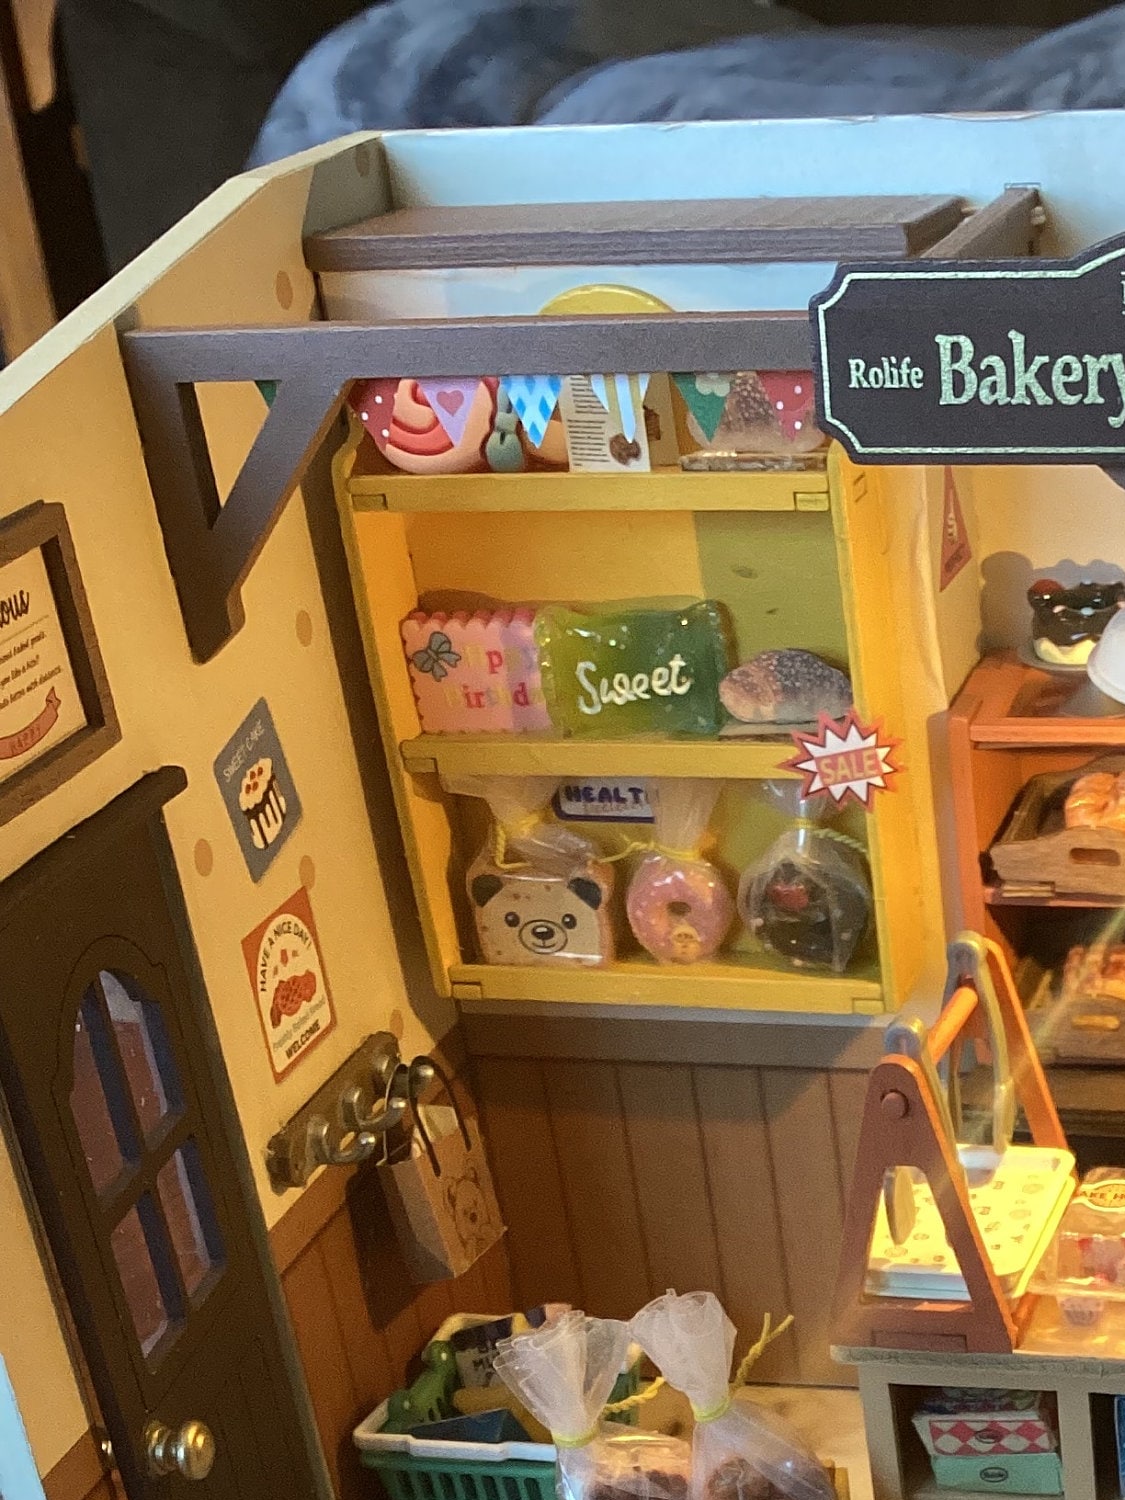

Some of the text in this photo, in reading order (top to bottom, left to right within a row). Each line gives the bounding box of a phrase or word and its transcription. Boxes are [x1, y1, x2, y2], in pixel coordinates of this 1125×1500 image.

[848, 357, 924, 392] Rolife
[575, 653, 693, 716] Sweet
[223, 719, 265, 783] SWEET CAKE
[820, 749, 877, 785] SALE
[260, 946, 271, 992] HAVE
[273, 920, 292, 942] NICE
[285, 1018, 321, 1060] WELCOME
